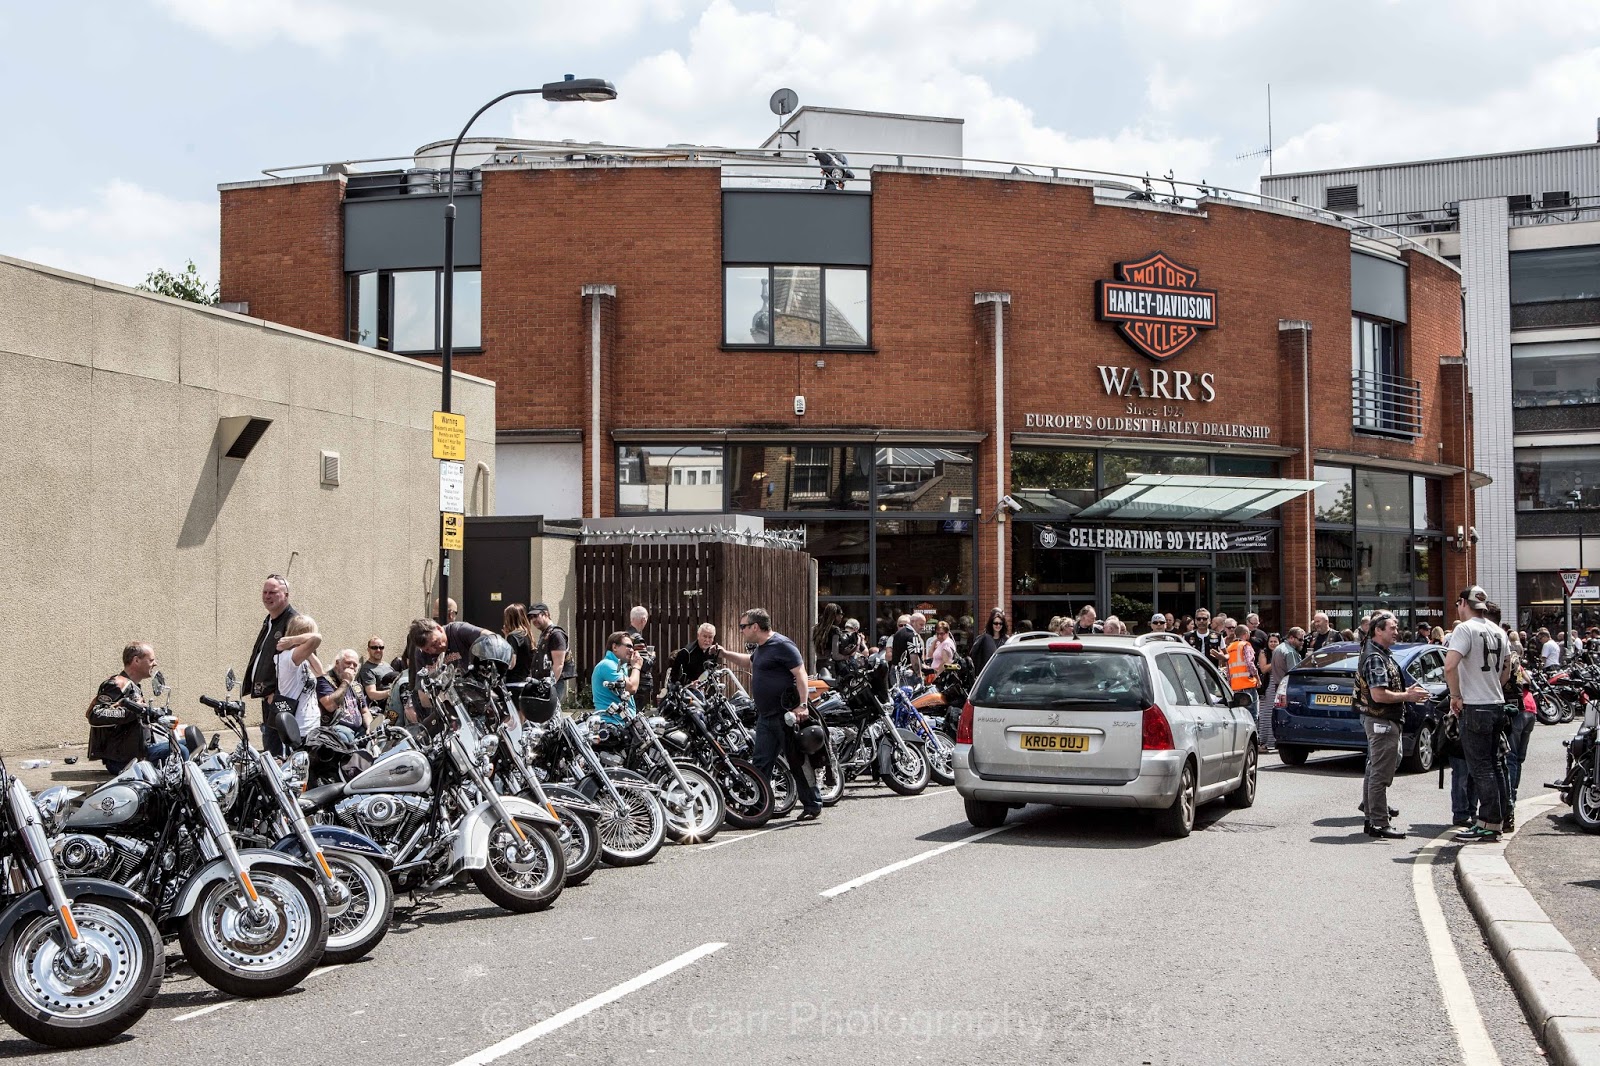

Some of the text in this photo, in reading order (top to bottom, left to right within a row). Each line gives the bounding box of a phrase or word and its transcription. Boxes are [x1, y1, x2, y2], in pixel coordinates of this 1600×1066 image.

[1133, 262, 1186, 287] MOTOR
[1109, 289, 1211, 320] HARLEY-DAVIDSON
[1134, 321, 1187, 351] CYCLES
[1097, 365, 1216, 403] WARR'S
[1025, 413, 1271, 439] EUROPE'S OLDEST HARLEY DEALERSHIP
[1044, 533, 1053, 543] 90
[1069, 527, 1229, 551] CELEBRATING 90 YEARS
[1316, 695, 1337, 703] RV09
[1025, 736, 1084, 749] KR06 OUJ
